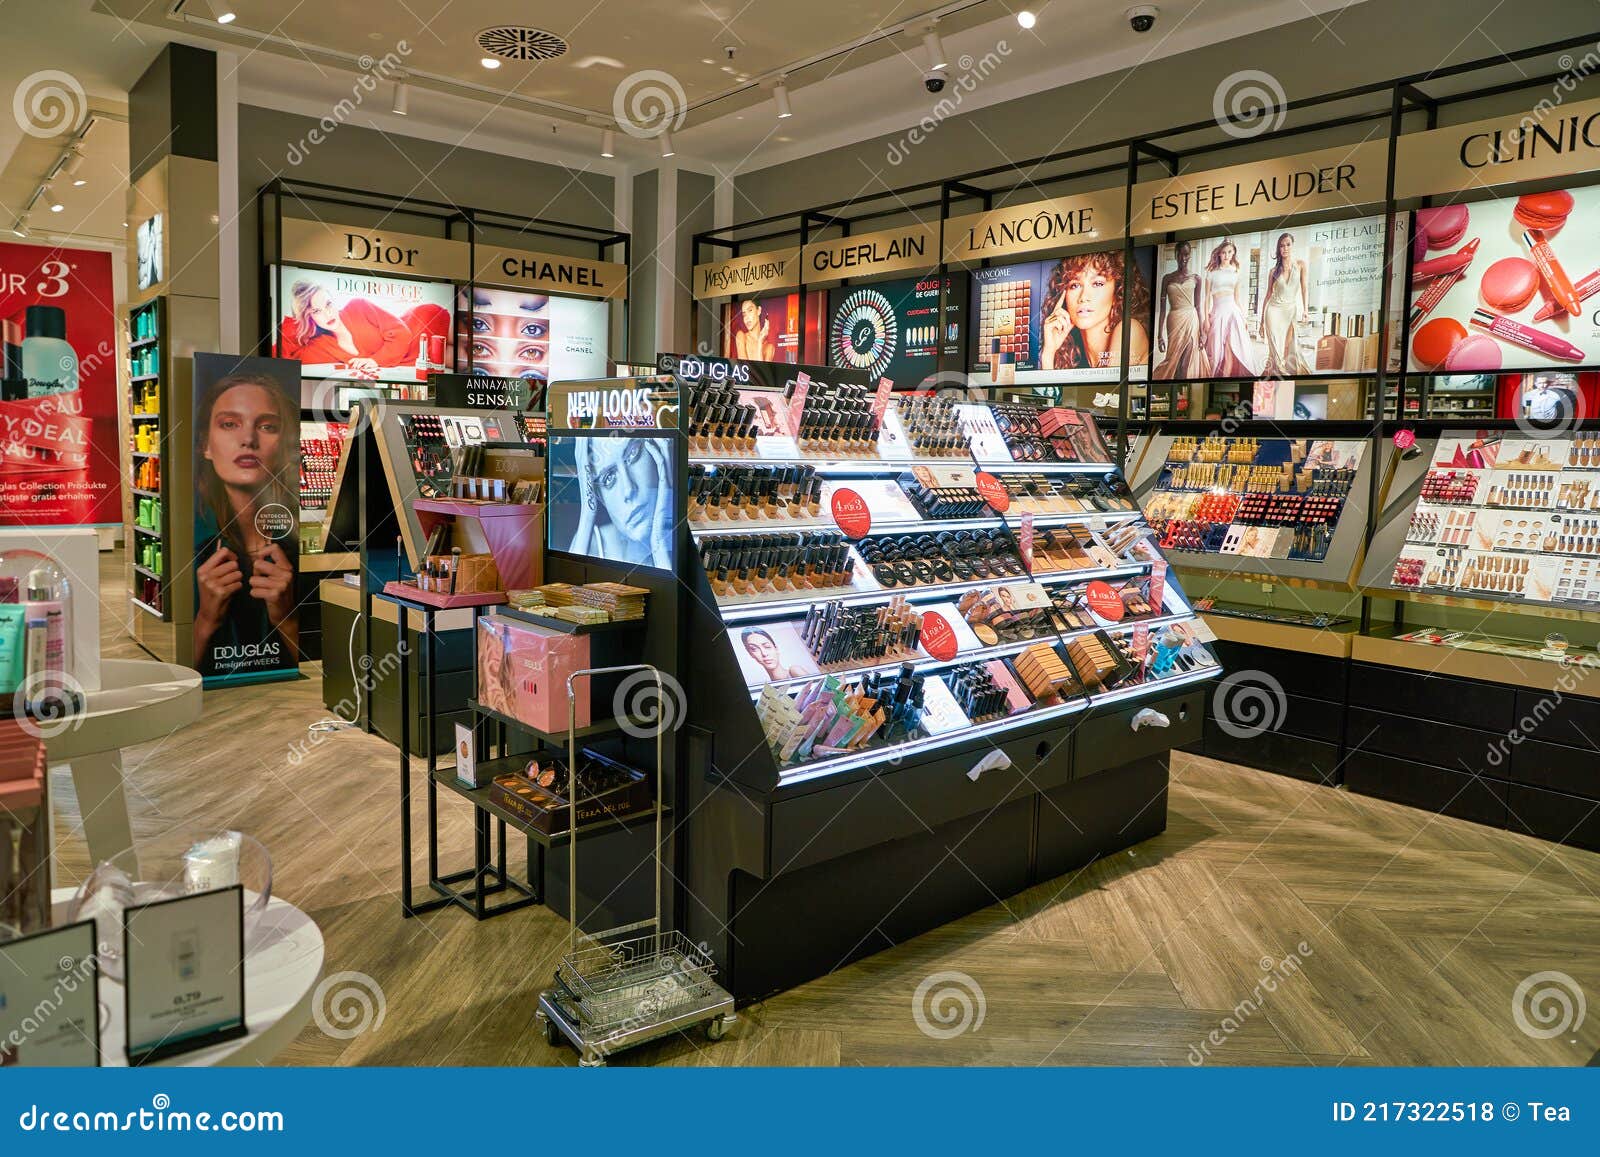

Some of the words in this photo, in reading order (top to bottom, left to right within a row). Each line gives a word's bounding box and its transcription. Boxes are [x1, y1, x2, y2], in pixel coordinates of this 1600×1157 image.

[1234, 164, 1357, 208] LAUDER
[968, 208, 1094, 251] LANCÔME
[343, 233, 420, 267] Dior
[813, 235, 925, 271] GUERLAIN
[502, 257, 605, 288] CHANEL
[466, 378, 521, 392] ANNAYAKE
[466, 393, 520, 407] SENSAI
[567, 391, 600, 417] NEW
[602, 387, 653, 417] LOOKS
[19, 481, 66, 490] Collection
[67, 481, 107, 490] Produkte
[31, 492, 57, 502] gratis
[58, 491, 97, 501] erhalten.
[855, 498, 863, 511] 3
[214, 642, 280, 660] DOUGLAS
[214, 660, 253, 670] Designer
[253, 656, 280, 666] WEEKS
